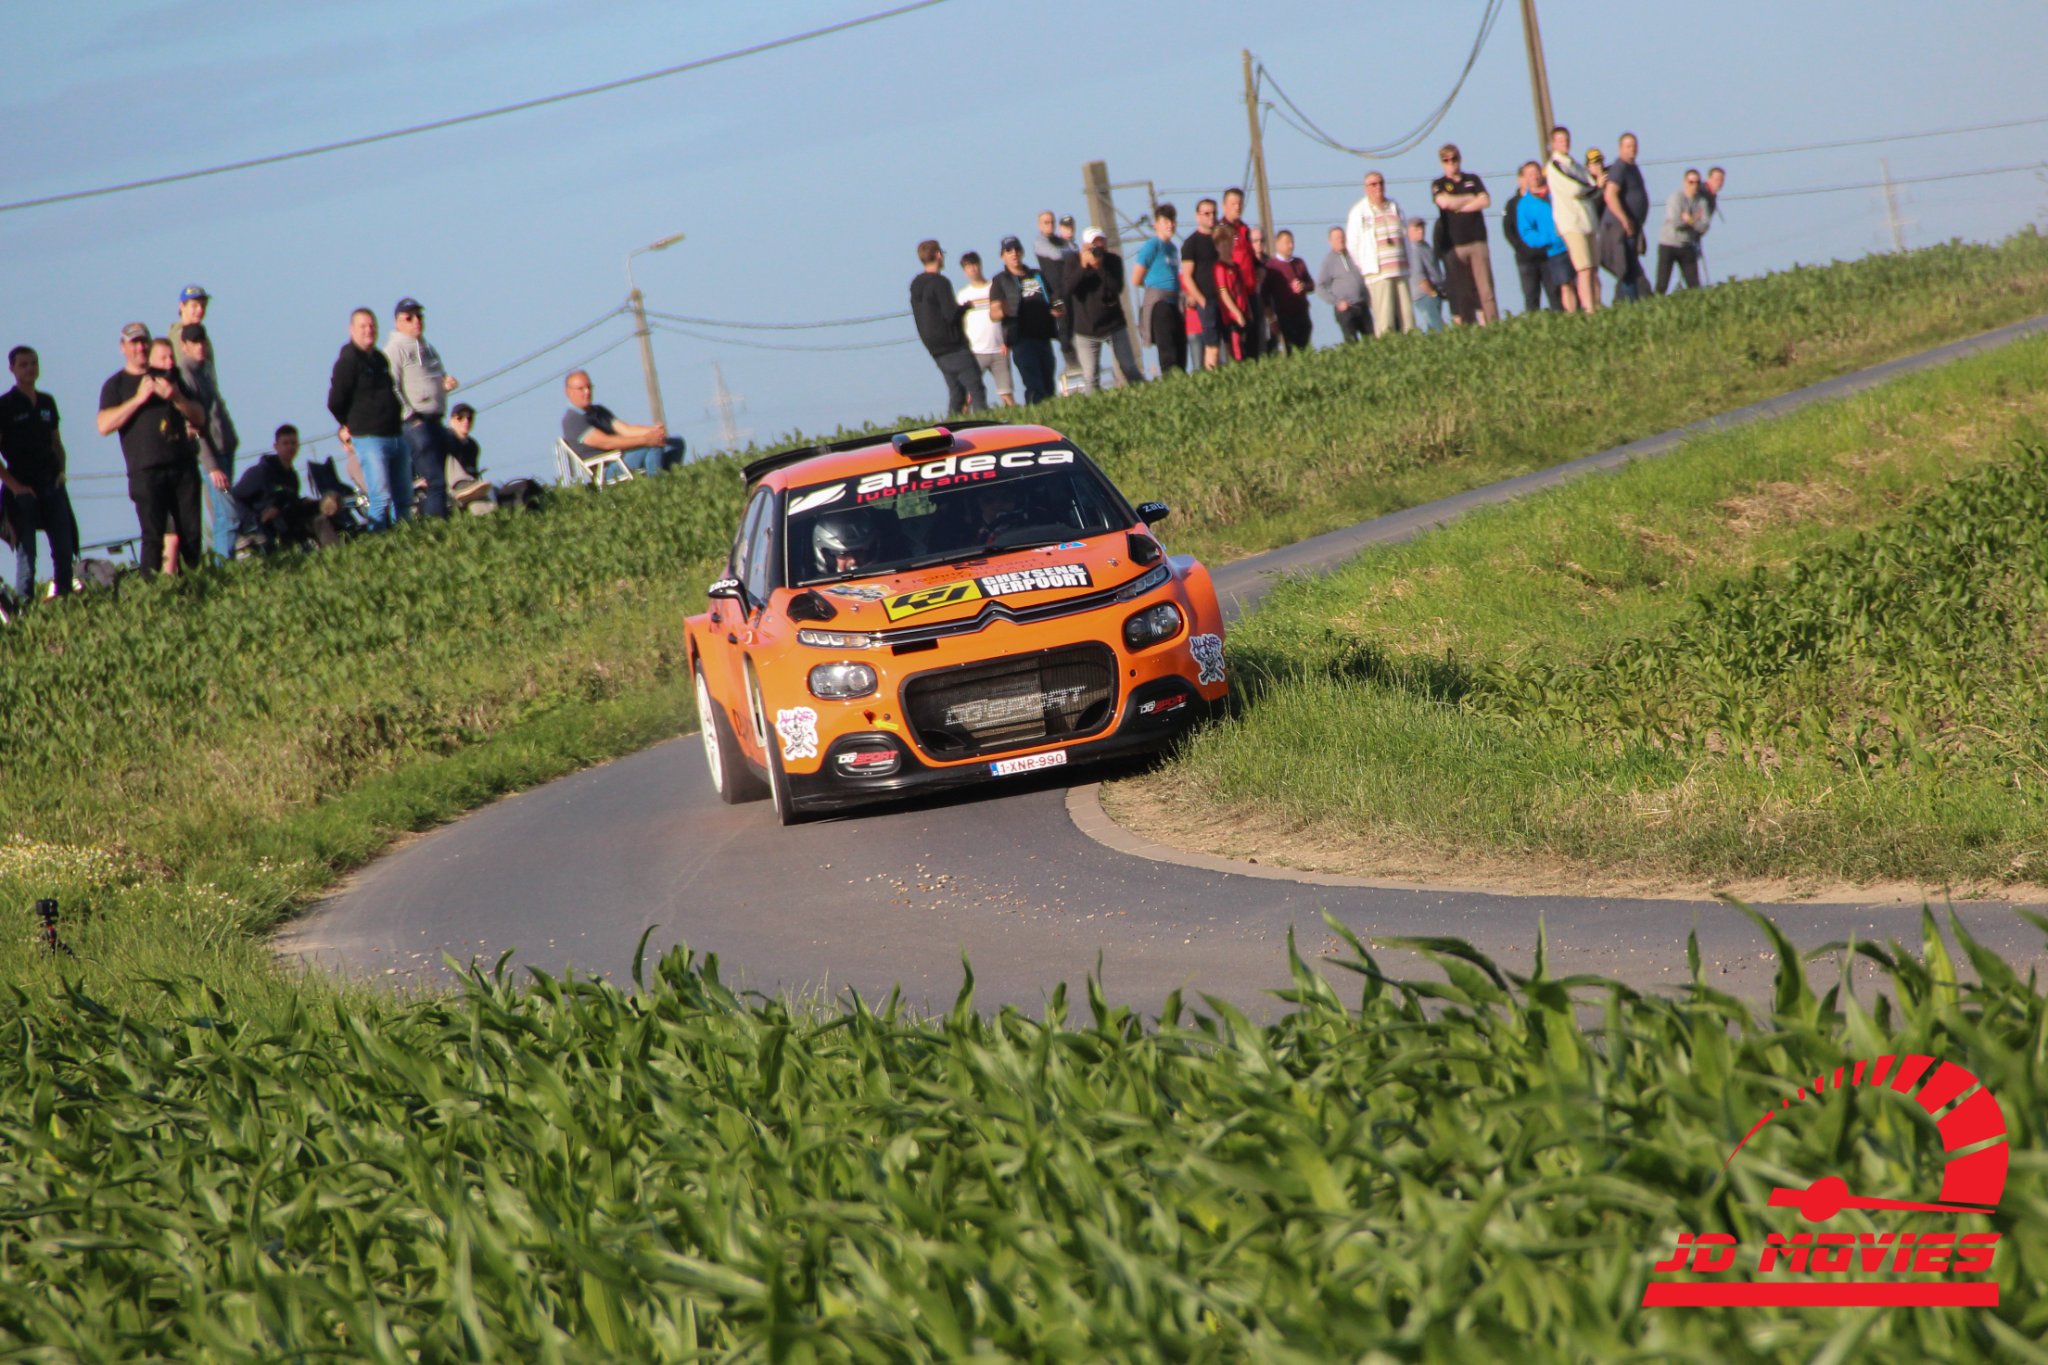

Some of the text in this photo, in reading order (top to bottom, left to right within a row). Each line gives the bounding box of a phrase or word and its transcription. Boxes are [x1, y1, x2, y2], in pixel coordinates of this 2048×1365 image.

[857, 450, 1074, 494] ardeca
[856, 470, 996, 504] lubricants
[984, 572, 1089, 596] VERPOORT
[1000, 753, 1064, 773] 1-XNR-990
